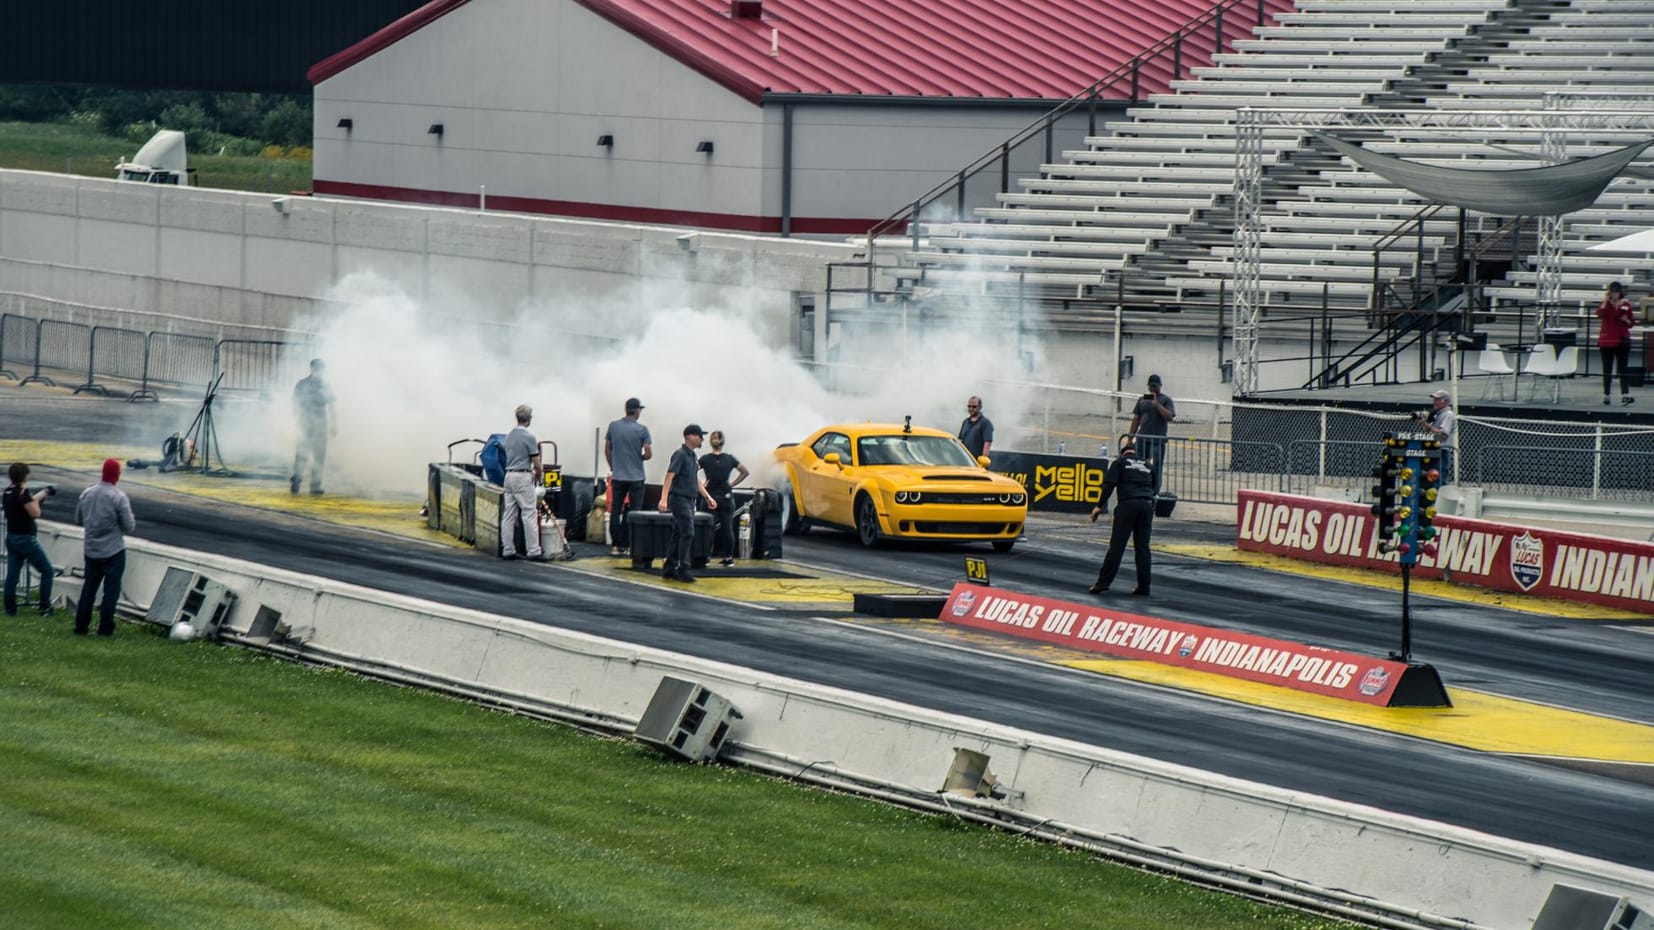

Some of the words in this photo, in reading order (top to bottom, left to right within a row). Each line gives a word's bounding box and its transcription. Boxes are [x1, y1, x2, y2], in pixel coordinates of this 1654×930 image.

[1035, 463, 1104, 486] Mello
[1240, 500, 1322, 551] LUCAS
[1323, 513, 1366, 557] OIL
[1367, 518, 1503, 576] RAEWAY
[1516, 551, 1540, 565] LUCAS
[974, 596, 1045, 629] LUCAS
[1042, 608, 1080, 636] OIL
[1077, 615, 1185, 655] RACEWAY
[1193, 637, 1359, 689] INDIANAPOLIS
